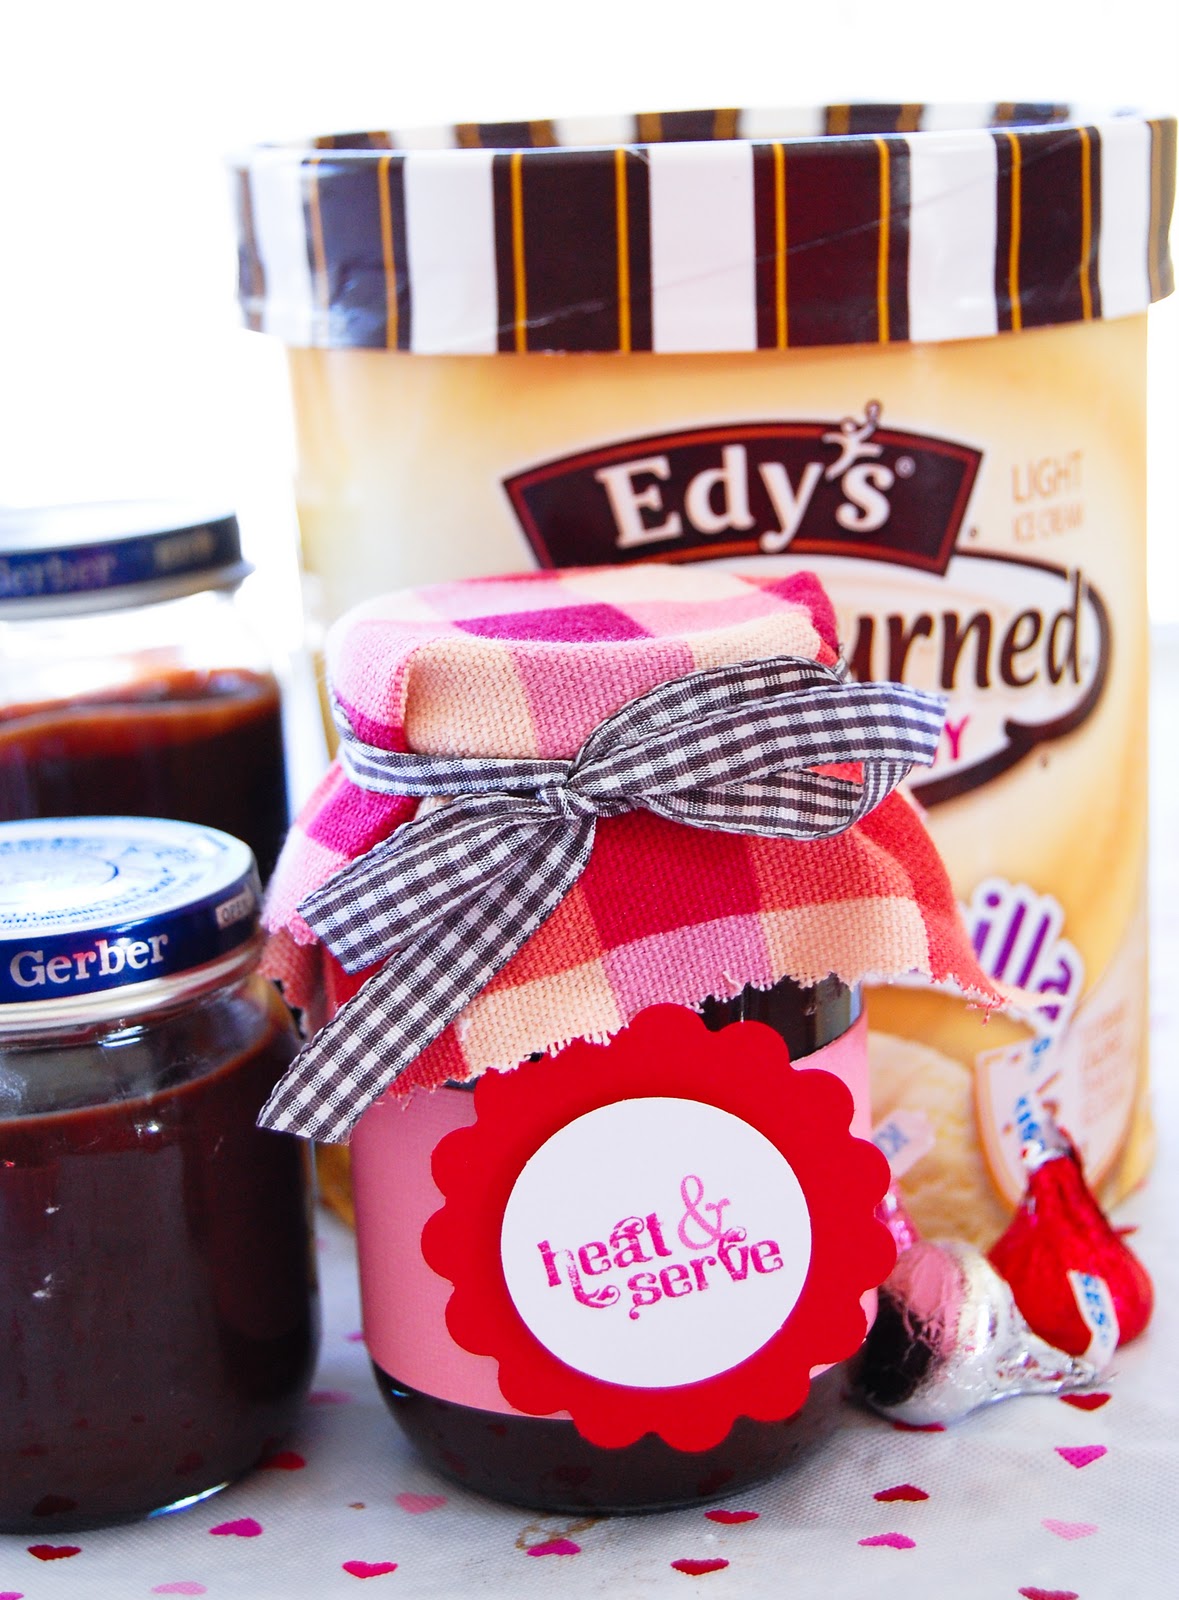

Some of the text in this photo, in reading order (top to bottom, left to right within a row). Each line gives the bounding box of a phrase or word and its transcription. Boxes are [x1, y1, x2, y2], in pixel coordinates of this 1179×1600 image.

[595, 438, 897, 554] Edy's
[9, 933, 169, 988] Gerber
[537, 1174, 731, 1308] heat &
[627, 1226, 784, 1320] serve
